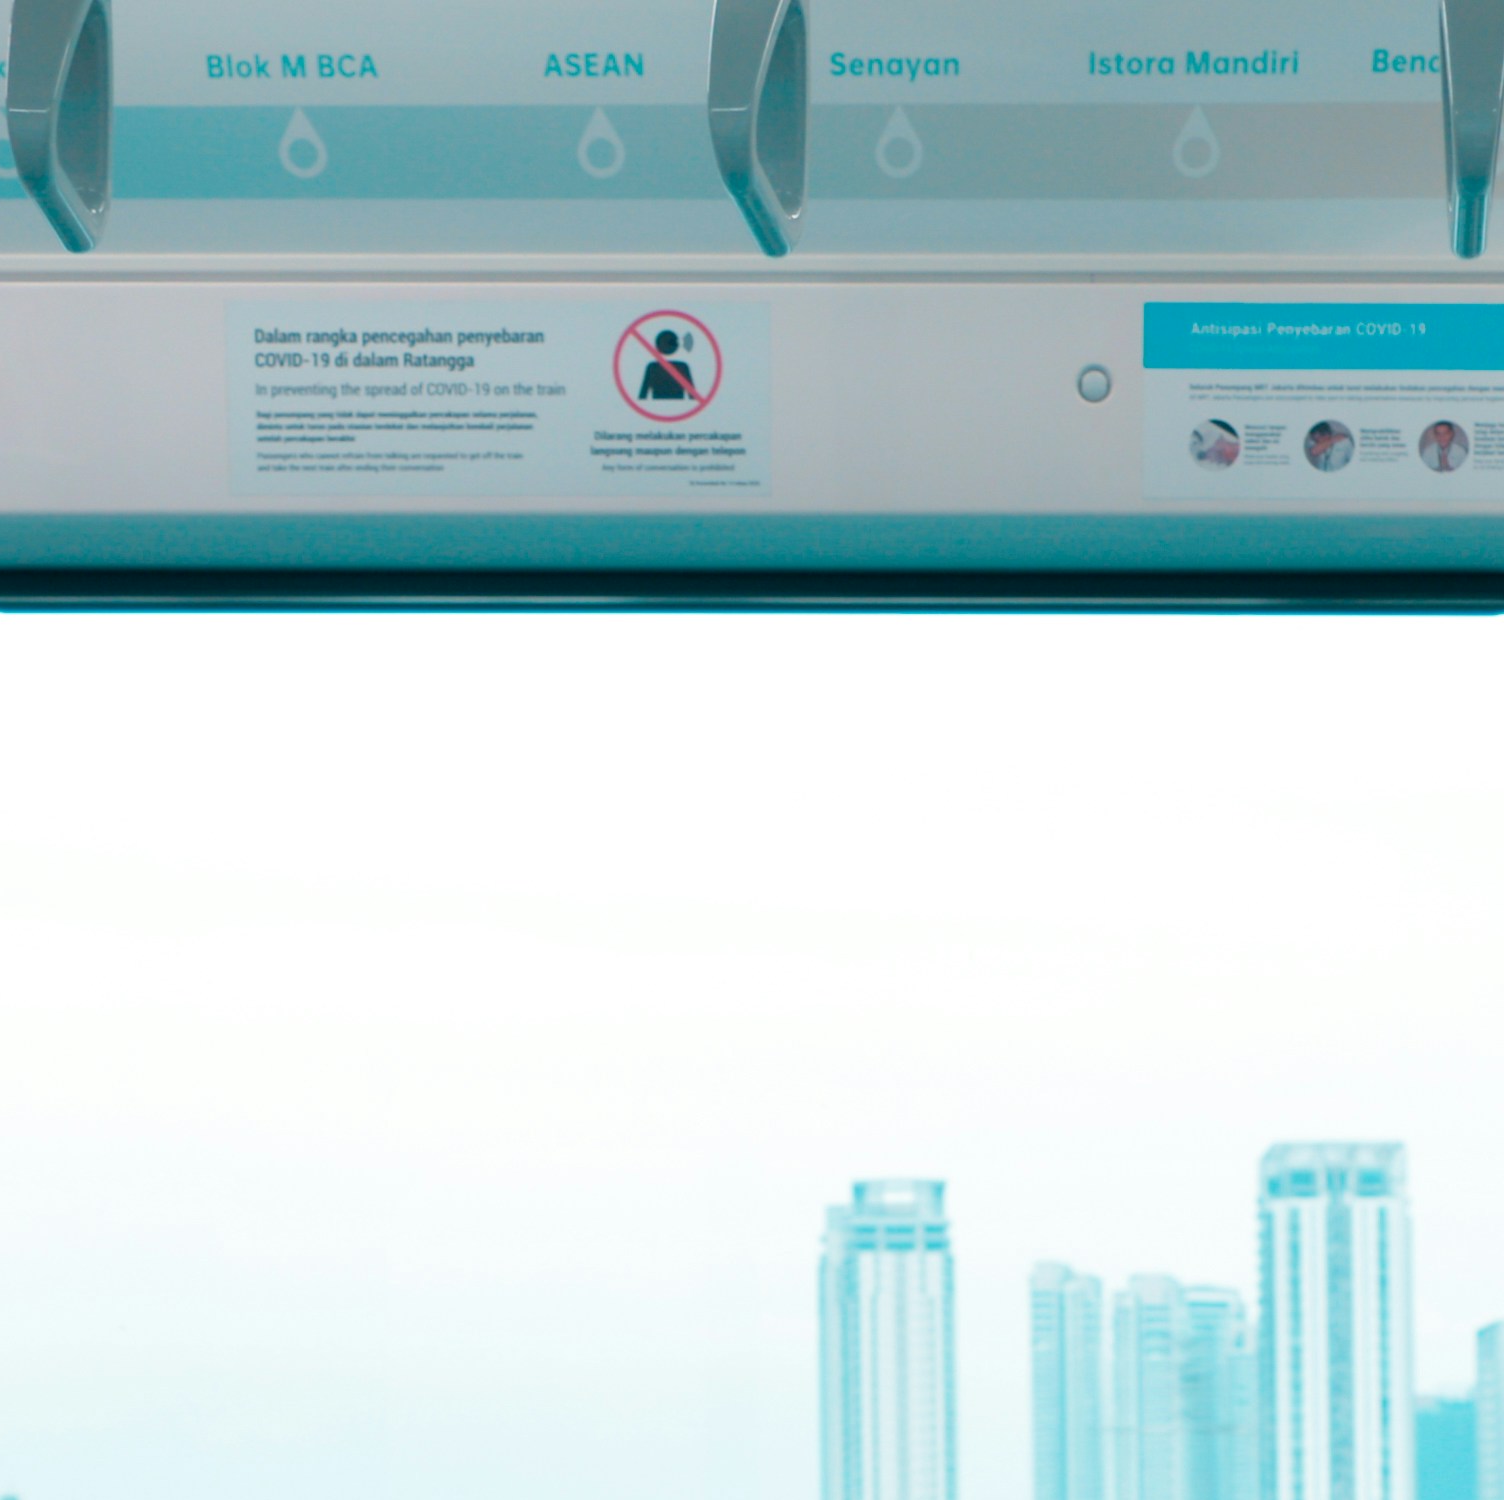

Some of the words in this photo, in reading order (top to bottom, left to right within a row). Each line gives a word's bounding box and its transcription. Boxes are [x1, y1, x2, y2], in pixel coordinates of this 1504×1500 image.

[207, 54, 270, 79] Blok
[281, 54, 306, 78] M
[317, 54, 378, 78] BCA
[545, 53, 644, 77] ASEAN
[830, 52, 959, 82] Senayan
[1089, 52, 1174, 75] Istora
[1186, 50, 1298, 75] Mandiri
[254, 328, 301, 344] Dalam
[306, 328, 357, 347] rangka
[362, 328, 452, 347] pencegahan
[457, 328, 544, 347] penyebaran
[1191, 322, 1261, 338] Antisipasi
[1267, 322, 1351, 338] Penyebaran
[335, 353, 347, 367] di
[353, 353, 398, 367] dalam
[404, 353, 475, 371] Ratangga
[256, 384, 267, 395] In
[271, 383, 338, 398] preventing
[341, 383, 360, 395] the
[365, 383, 406, 398] spread
[410, 383, 424, 395] of
[494, 387, 509, 395] on
[514, 383, 534, 395] the
[537, 383, 566, 395] train
